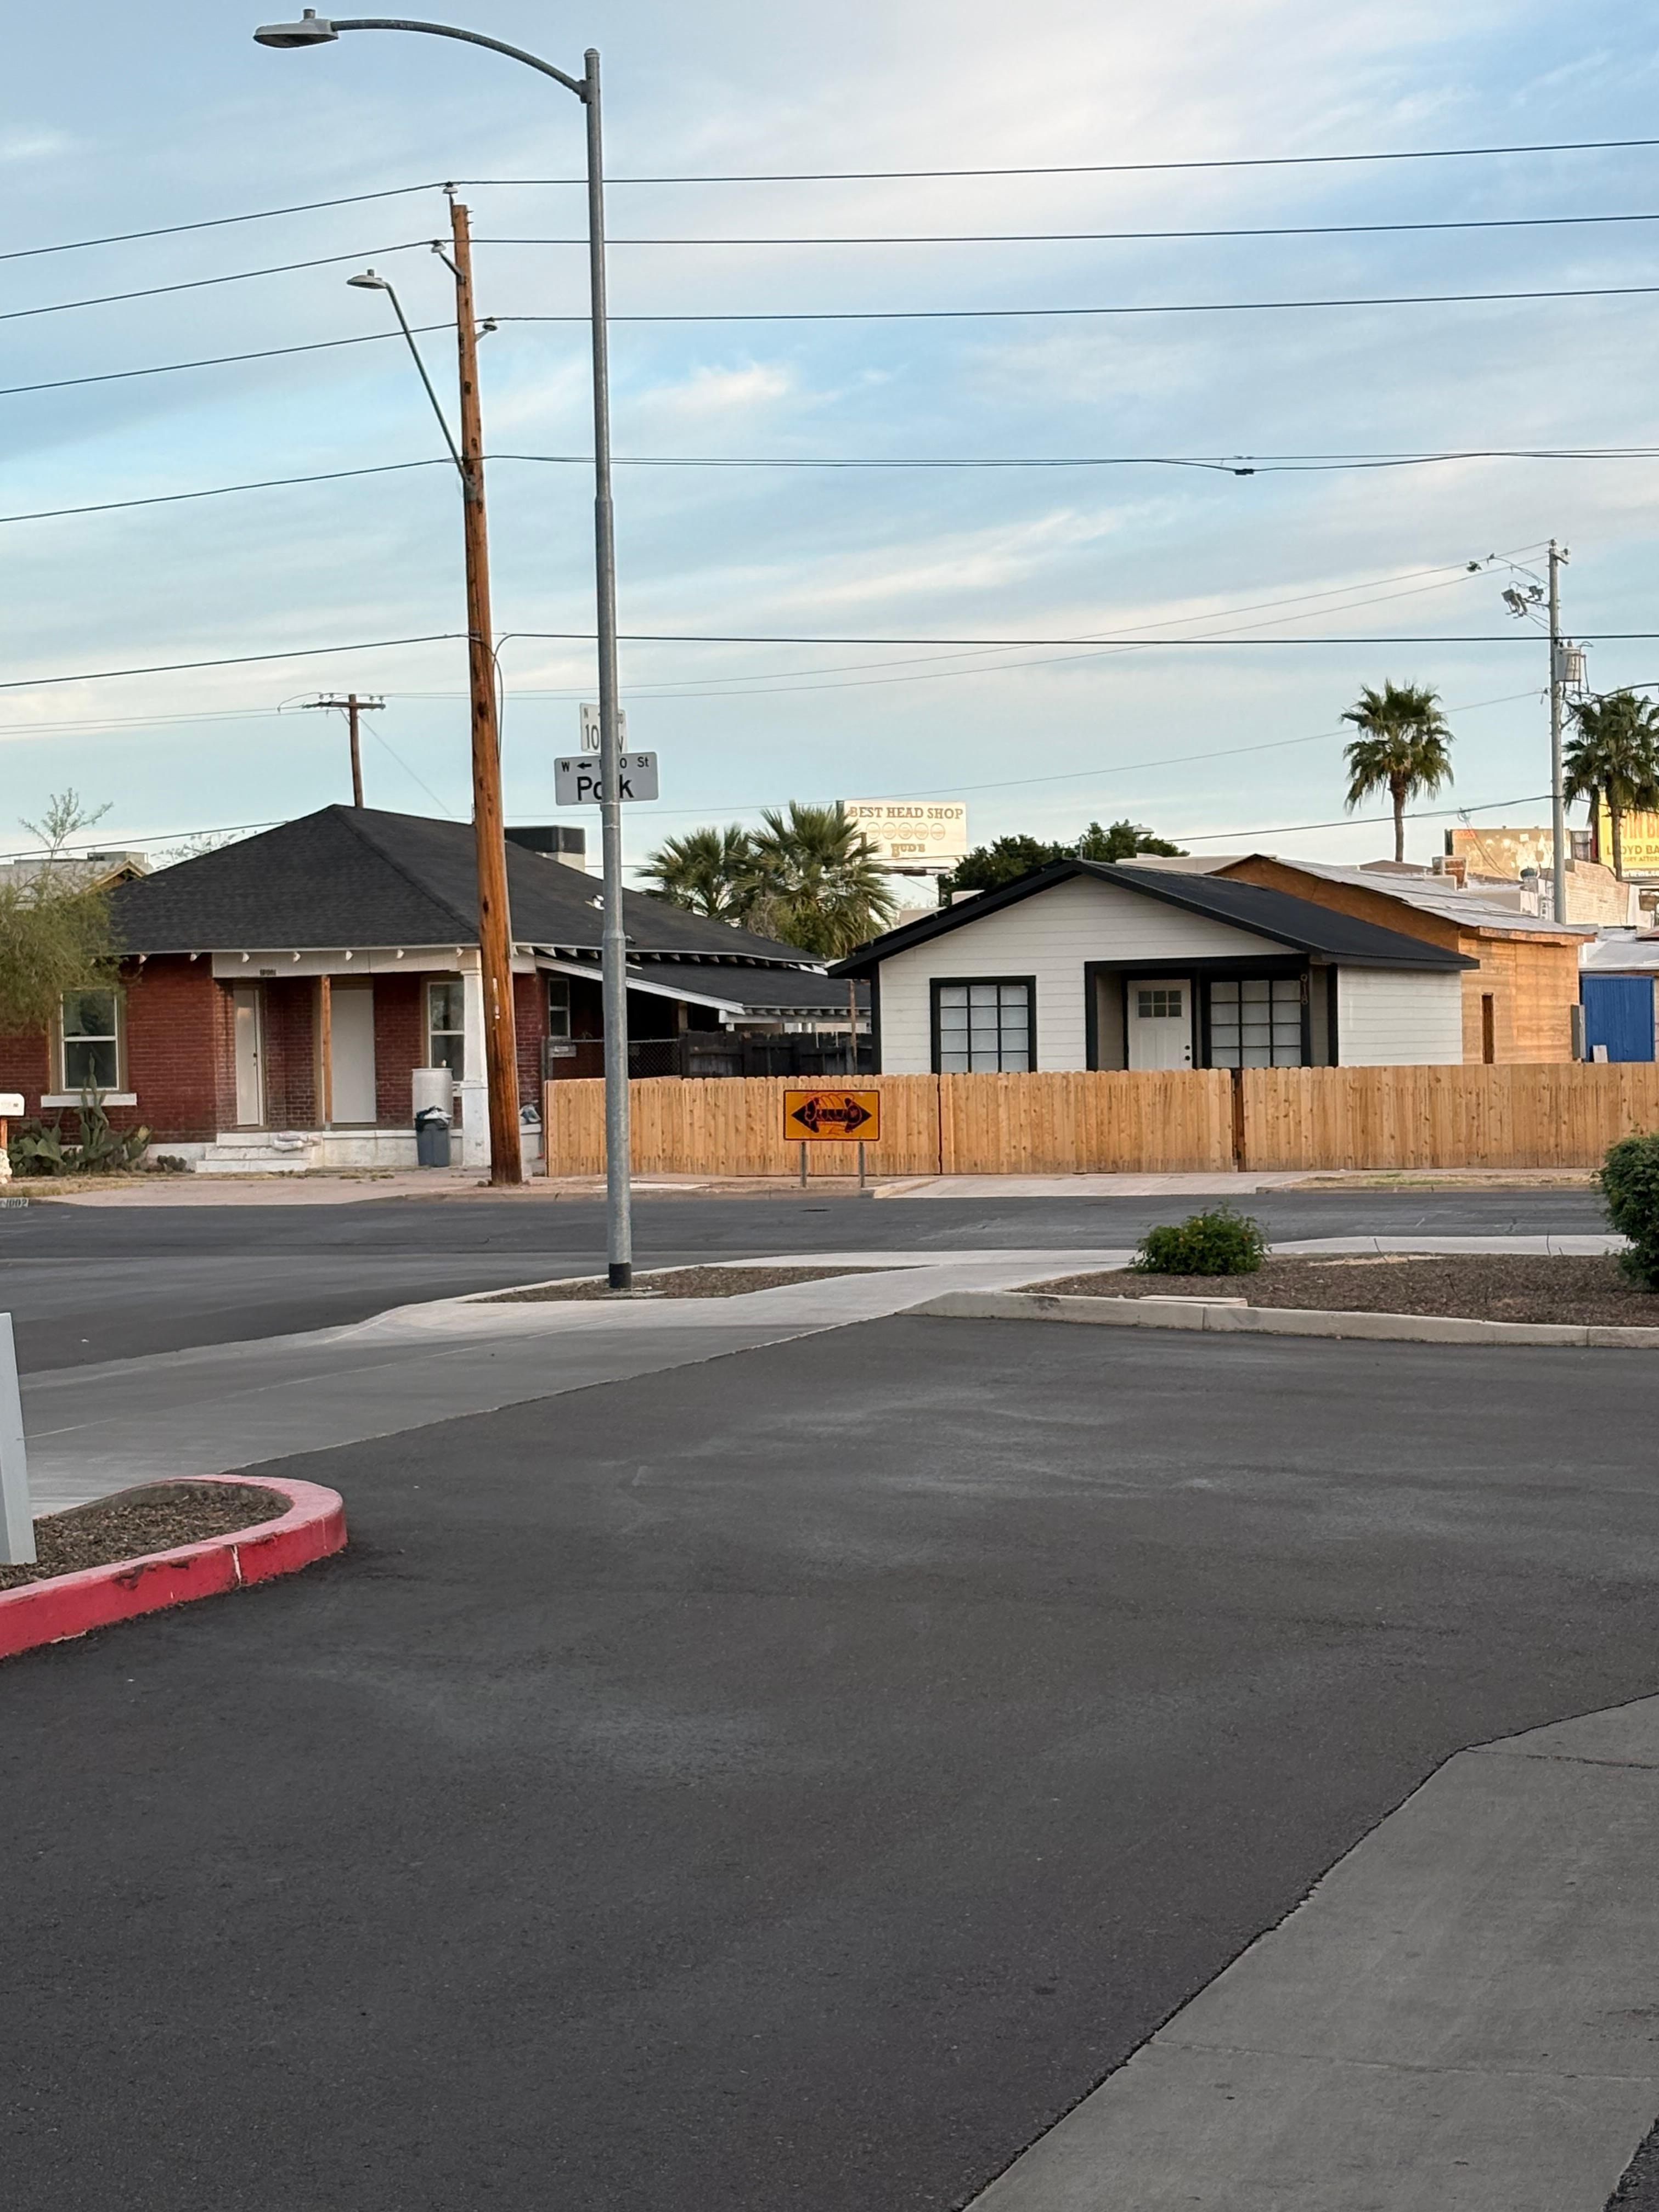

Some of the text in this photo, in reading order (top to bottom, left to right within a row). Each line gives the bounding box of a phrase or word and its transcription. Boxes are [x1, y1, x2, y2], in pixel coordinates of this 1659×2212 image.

[561, 761, 570, 772] W
[637, 757, 650, 768] St
[849, 807, 963, 819] BEST HEAD SHOP
